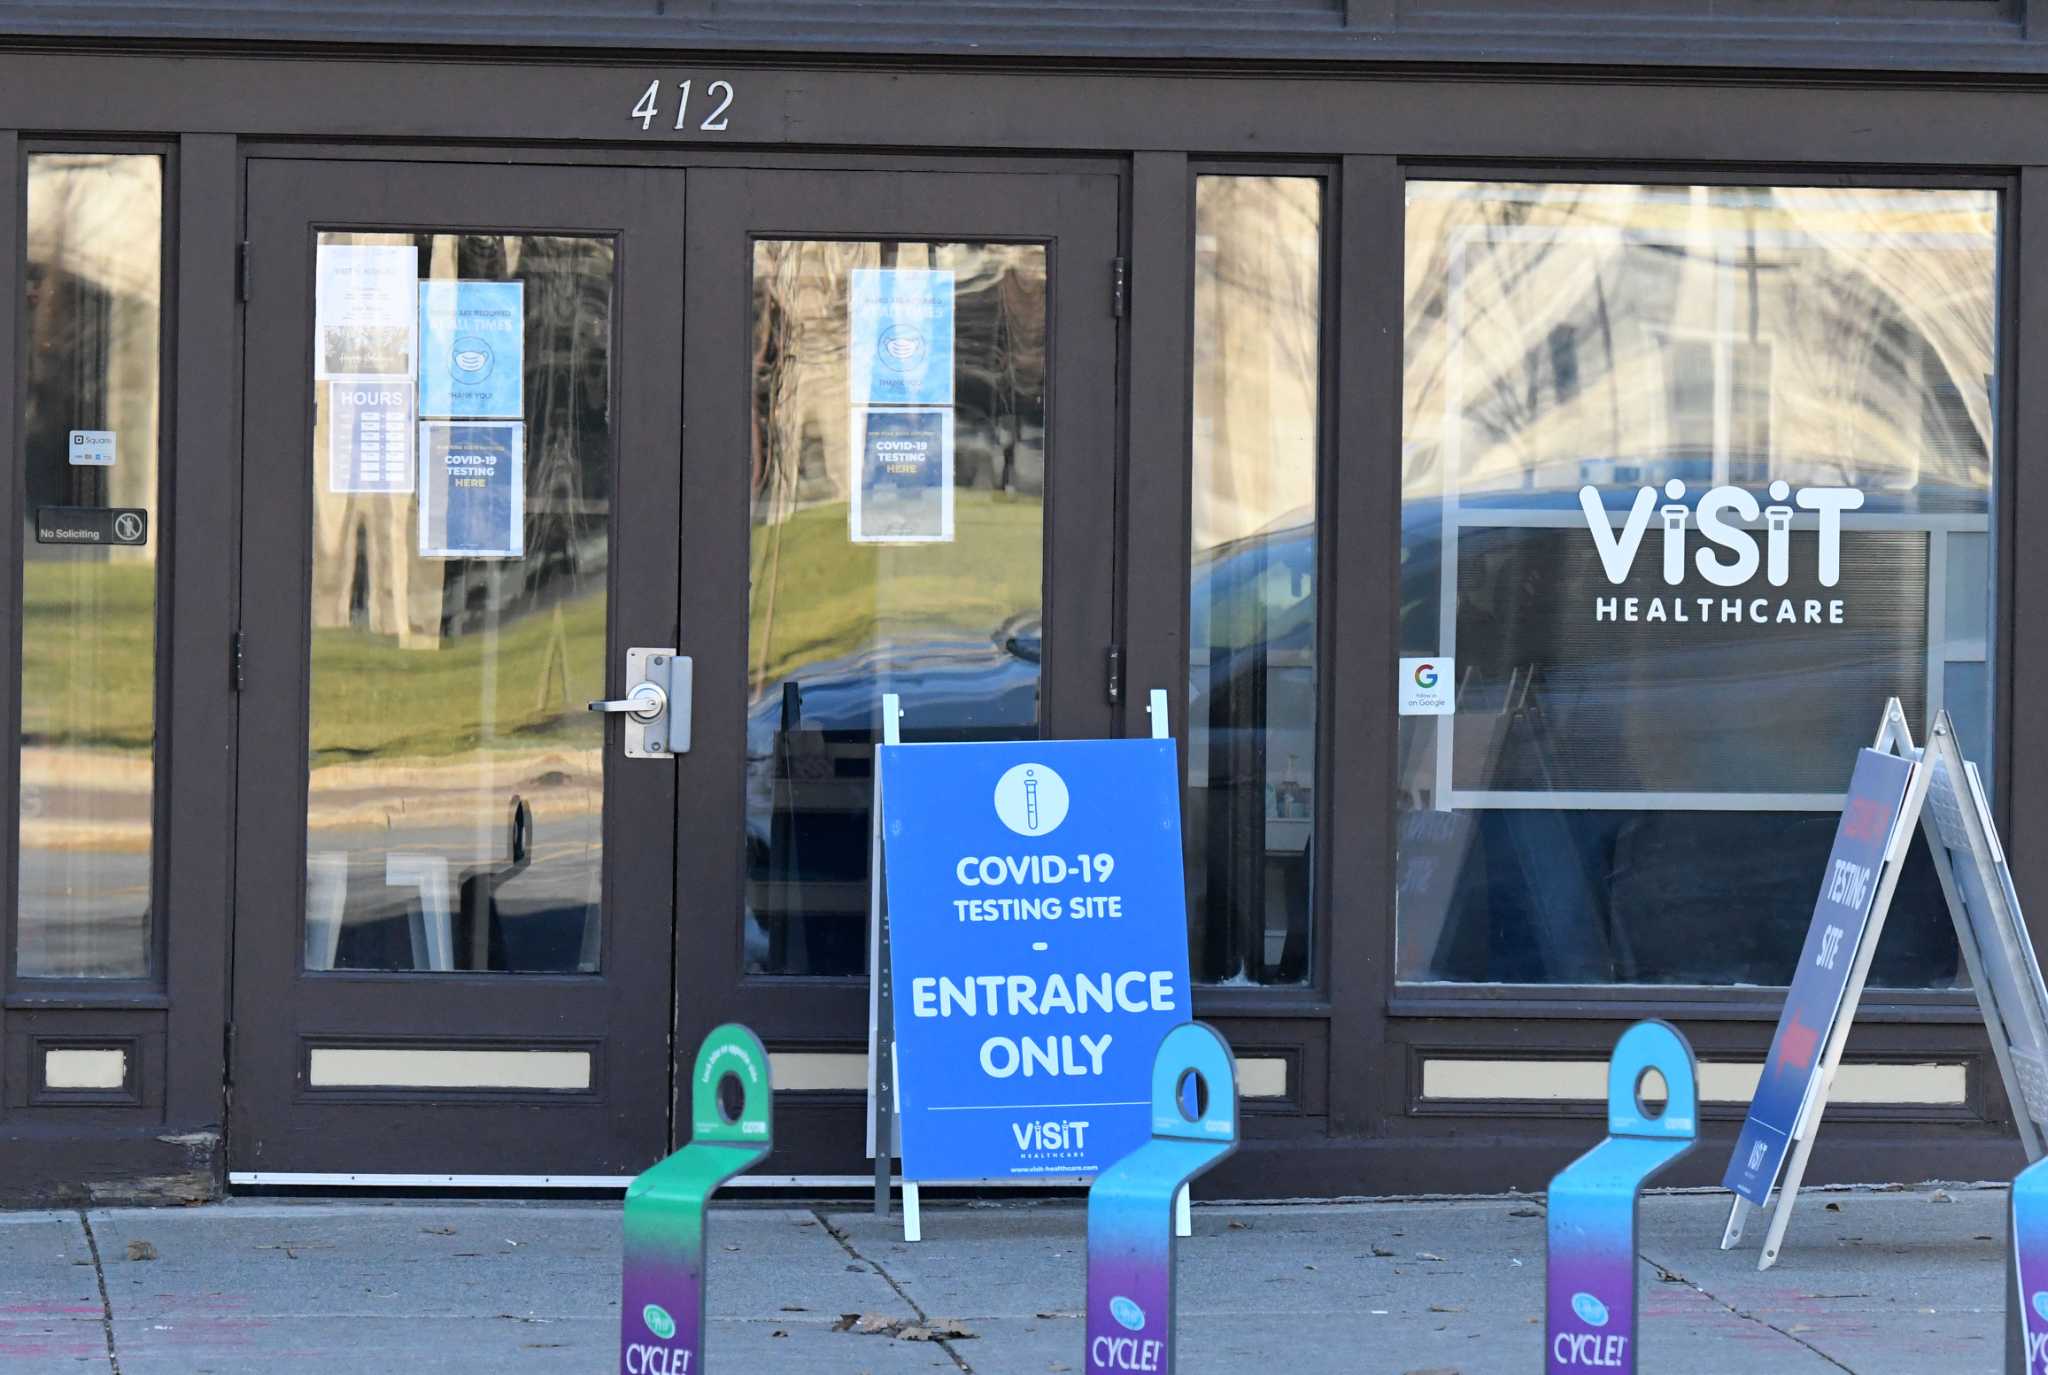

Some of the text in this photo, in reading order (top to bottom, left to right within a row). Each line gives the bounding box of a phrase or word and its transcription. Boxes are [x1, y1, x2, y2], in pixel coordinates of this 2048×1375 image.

[632, 80, 733, 130] 412
[341, 391, 403, 405] HOURS
[876, 441, 928, 450] COVID-19
[878, 453, 926, 462] TESTING
[444, 456, 497, 465] COVID-19
[447, 467, 494, 476] TESTING
[455, 479, 486, 488] HERE
[40, 529, 100, 541] No Soliciting
[1596, 597, 1844, 624] HEALTHCARE
[956, 853, 1115, 886] COVID-19
[1826, 858, 1872, 911] TESTING
[953, 896, 1122, 922] TESTING SITE
[1815, 924, 1844, 970] SITE
[912, 971, 1176, 1018] ENTRANCE
[979, 1034, 1113, 1078] ONLY
[1020, 1151, 1085, 1159] HEALTHCARE
[626, 1343, 690, 1375] CYCLE!
[1092, 1335, 1160, 1371] CYCLE!
[1553, 1332, 1625, 1367] CYCLE!
